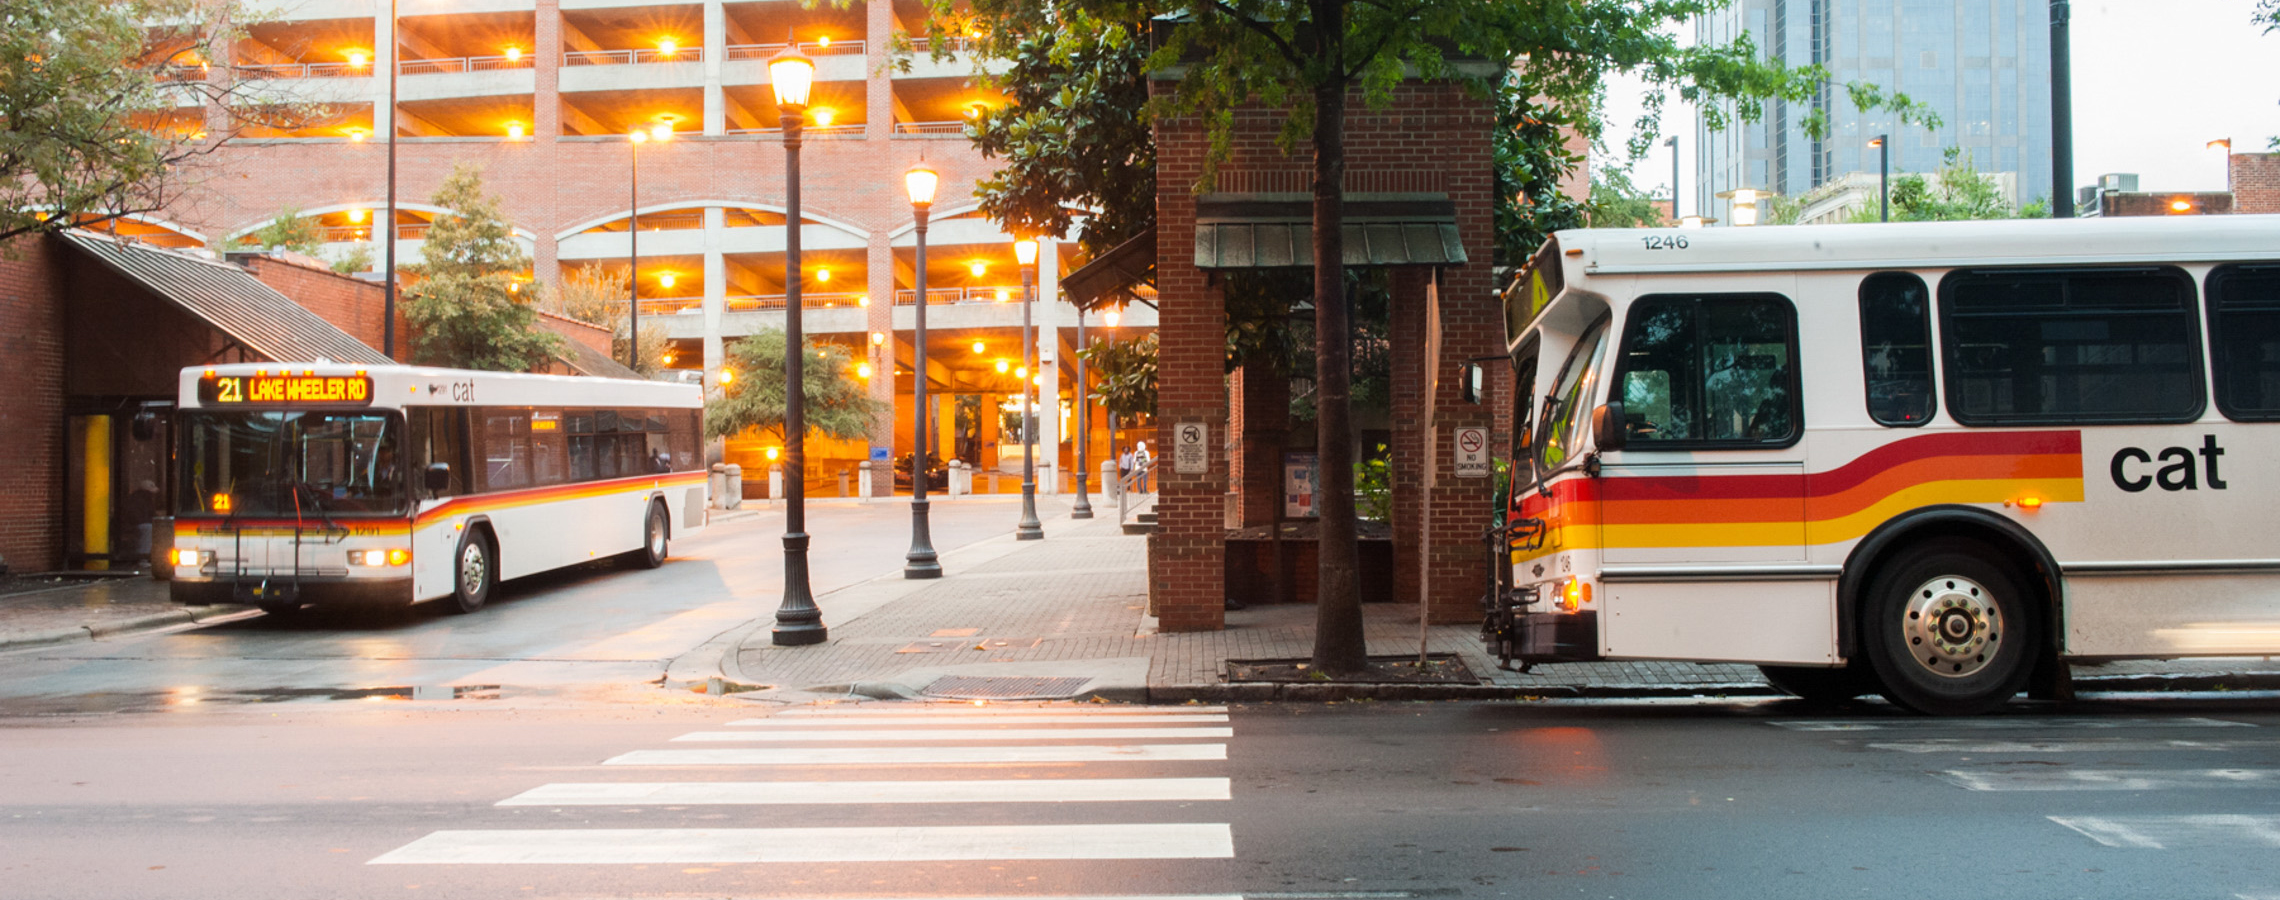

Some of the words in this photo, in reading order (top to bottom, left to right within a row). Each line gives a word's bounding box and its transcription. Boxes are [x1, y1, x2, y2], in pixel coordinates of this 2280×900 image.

[1641, 235, 1689, 250] 1246
[218, 377, 242, 402] 21
[249, 378, 285, 401] LAKE
[286, 378, 345, 401] WHEELER
[347, 378, 366, 401] RD
[452, 378, 475, 402] cat
[2110, 434, 2227, 493] cat
[213, 493, 231, 510] 21
